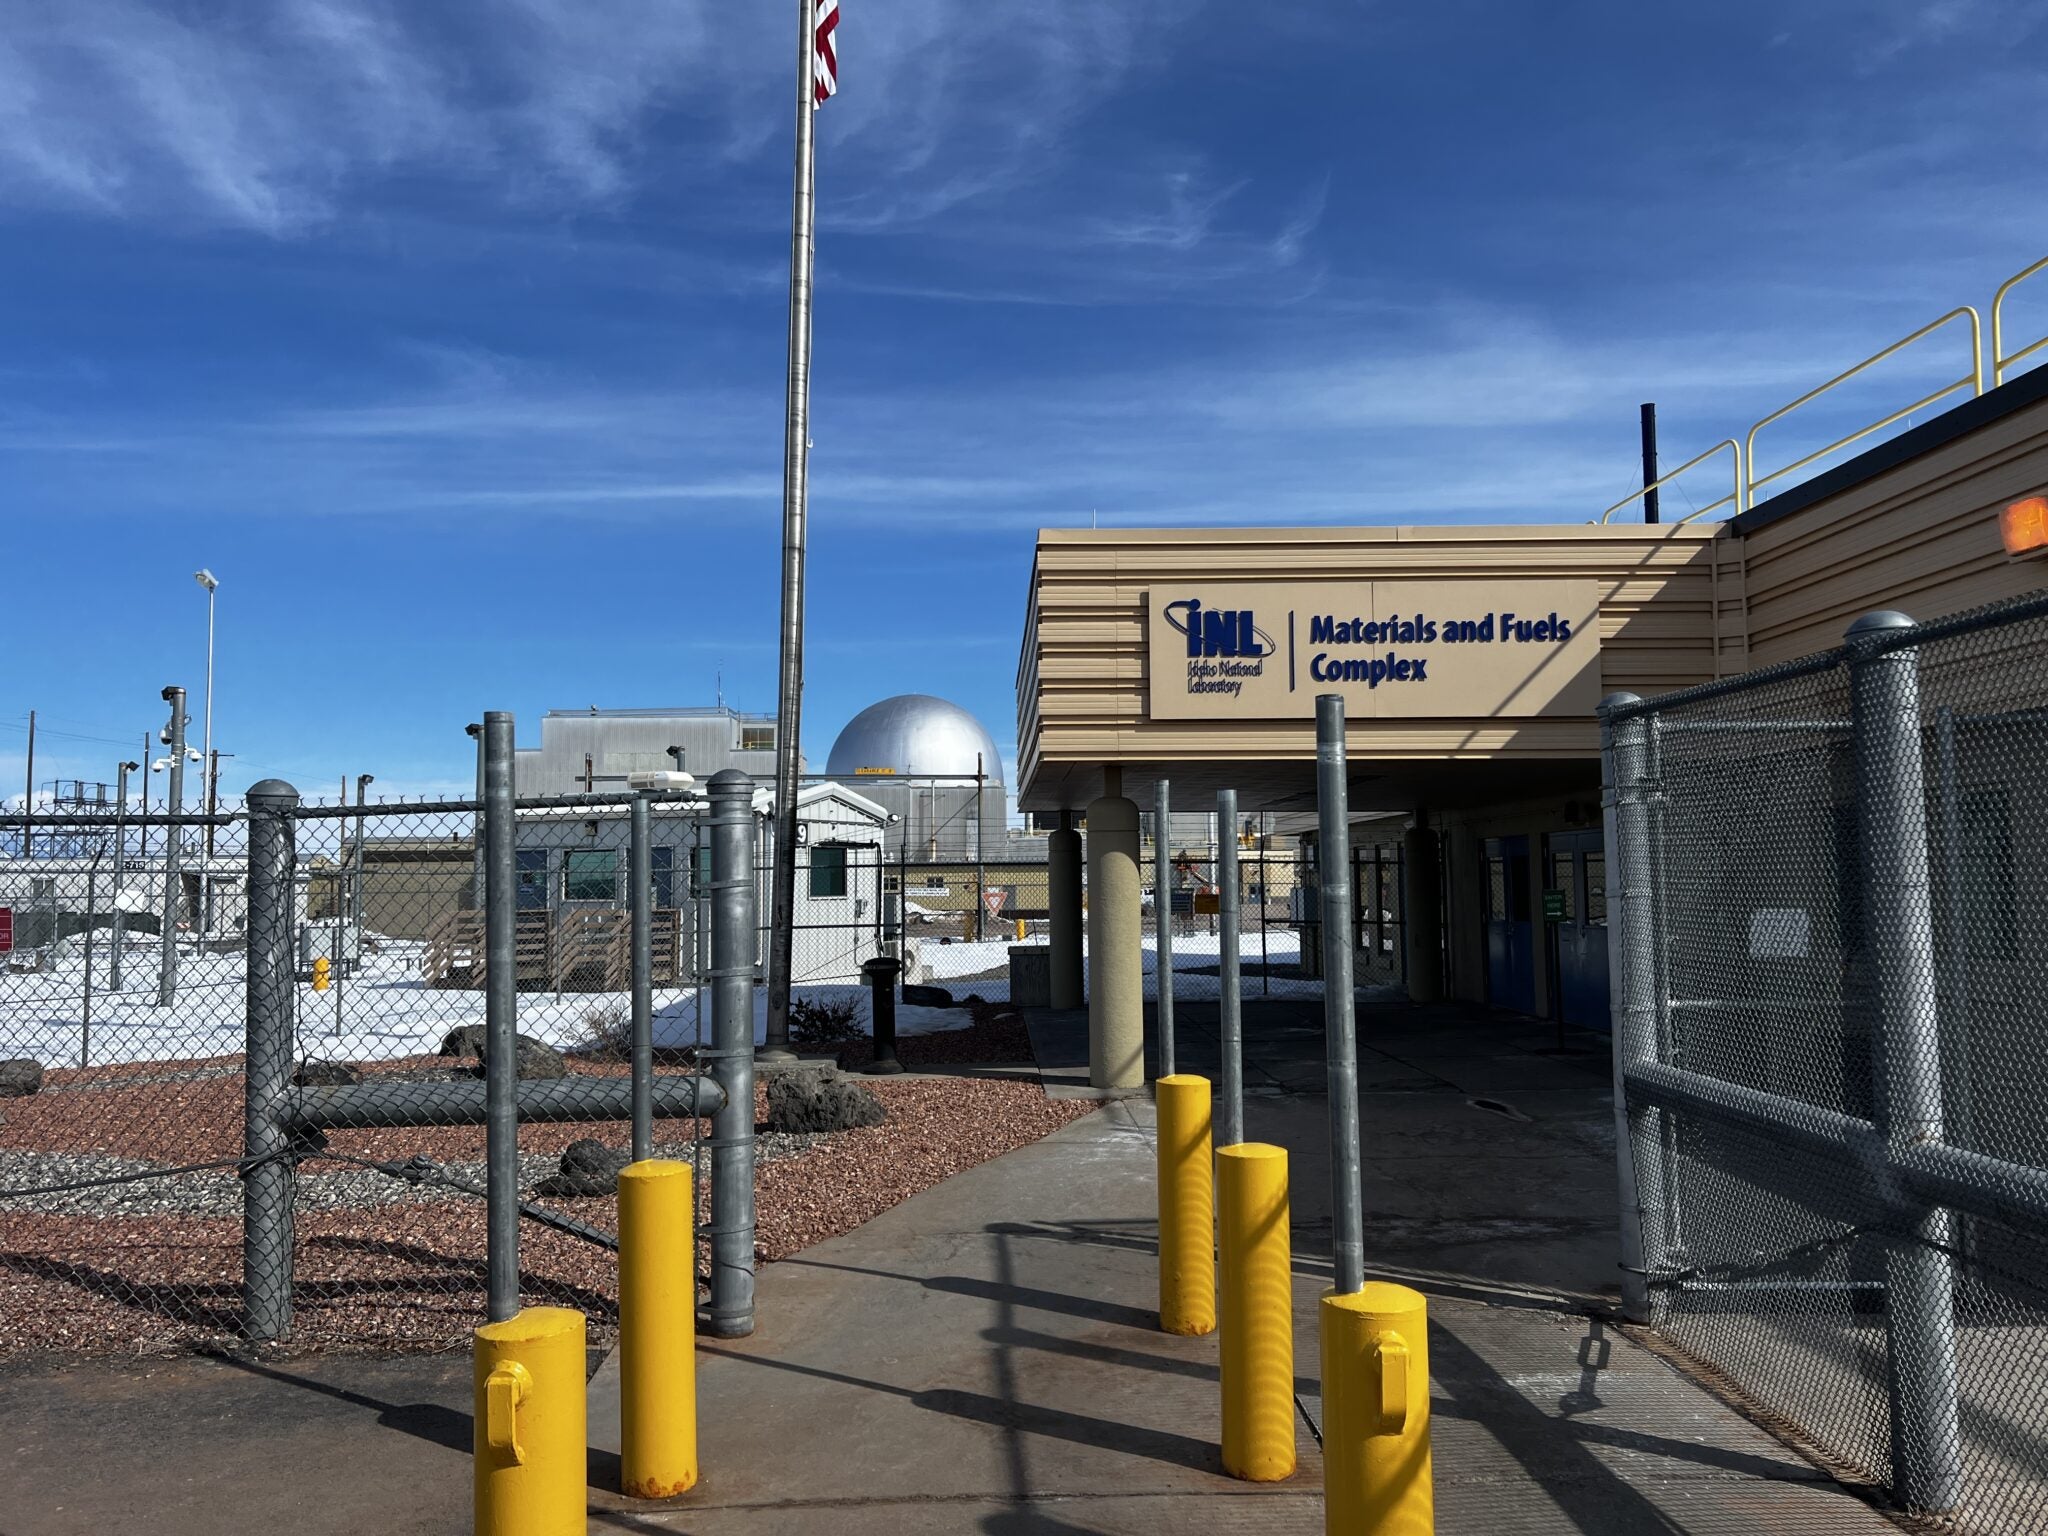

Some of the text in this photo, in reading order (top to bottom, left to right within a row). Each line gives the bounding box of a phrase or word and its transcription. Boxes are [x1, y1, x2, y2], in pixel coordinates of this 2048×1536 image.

[1310, 612, 1571, 644] Materials and Fuels
[1187, 659, 1262, 677] Idaho National
[1310, 652, 1427, 689] Complex
[1187, 678, 1242, 698] Laboratory
[797, 824, 807, 843] 9
